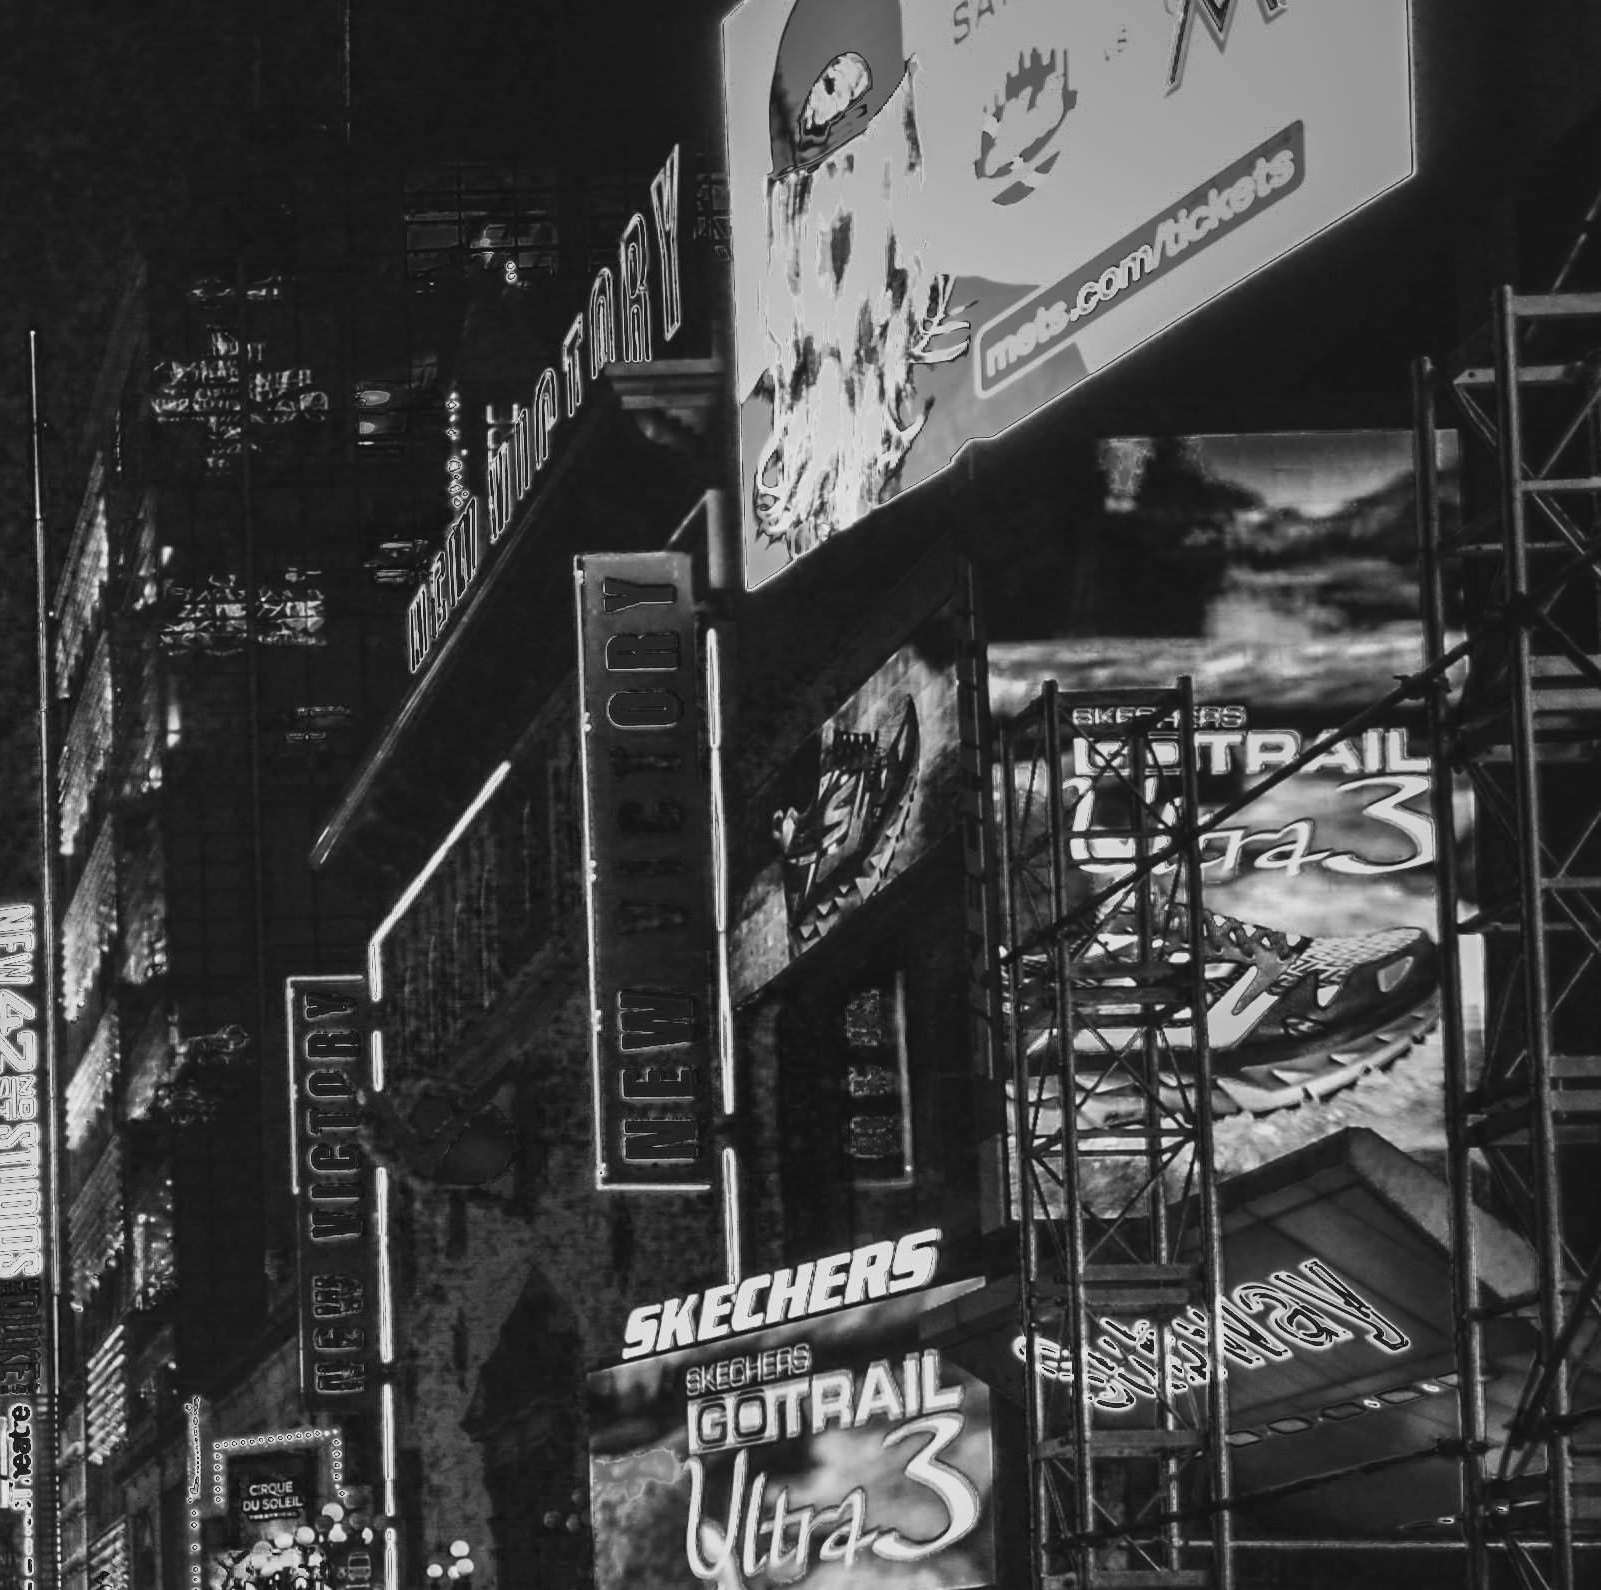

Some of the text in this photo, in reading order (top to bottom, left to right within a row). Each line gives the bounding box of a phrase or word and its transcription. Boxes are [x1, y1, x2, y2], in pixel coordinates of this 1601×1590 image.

[985, 147, 1296, 378] mets.com/tickets
[1321, 774, 1437, 876] 3
[621, 1228, 944, 1361] SKECHERS
[686, 1342, 812, 1397] SKECHERS
[689, 1349, 964, 1455] GOTRAIL
[249, 1480, 294, 1499] CIRQUE
[262, 1494, 304, 1511] SOLEIL
[684, 1410, 980, 1581] Ultra 3
